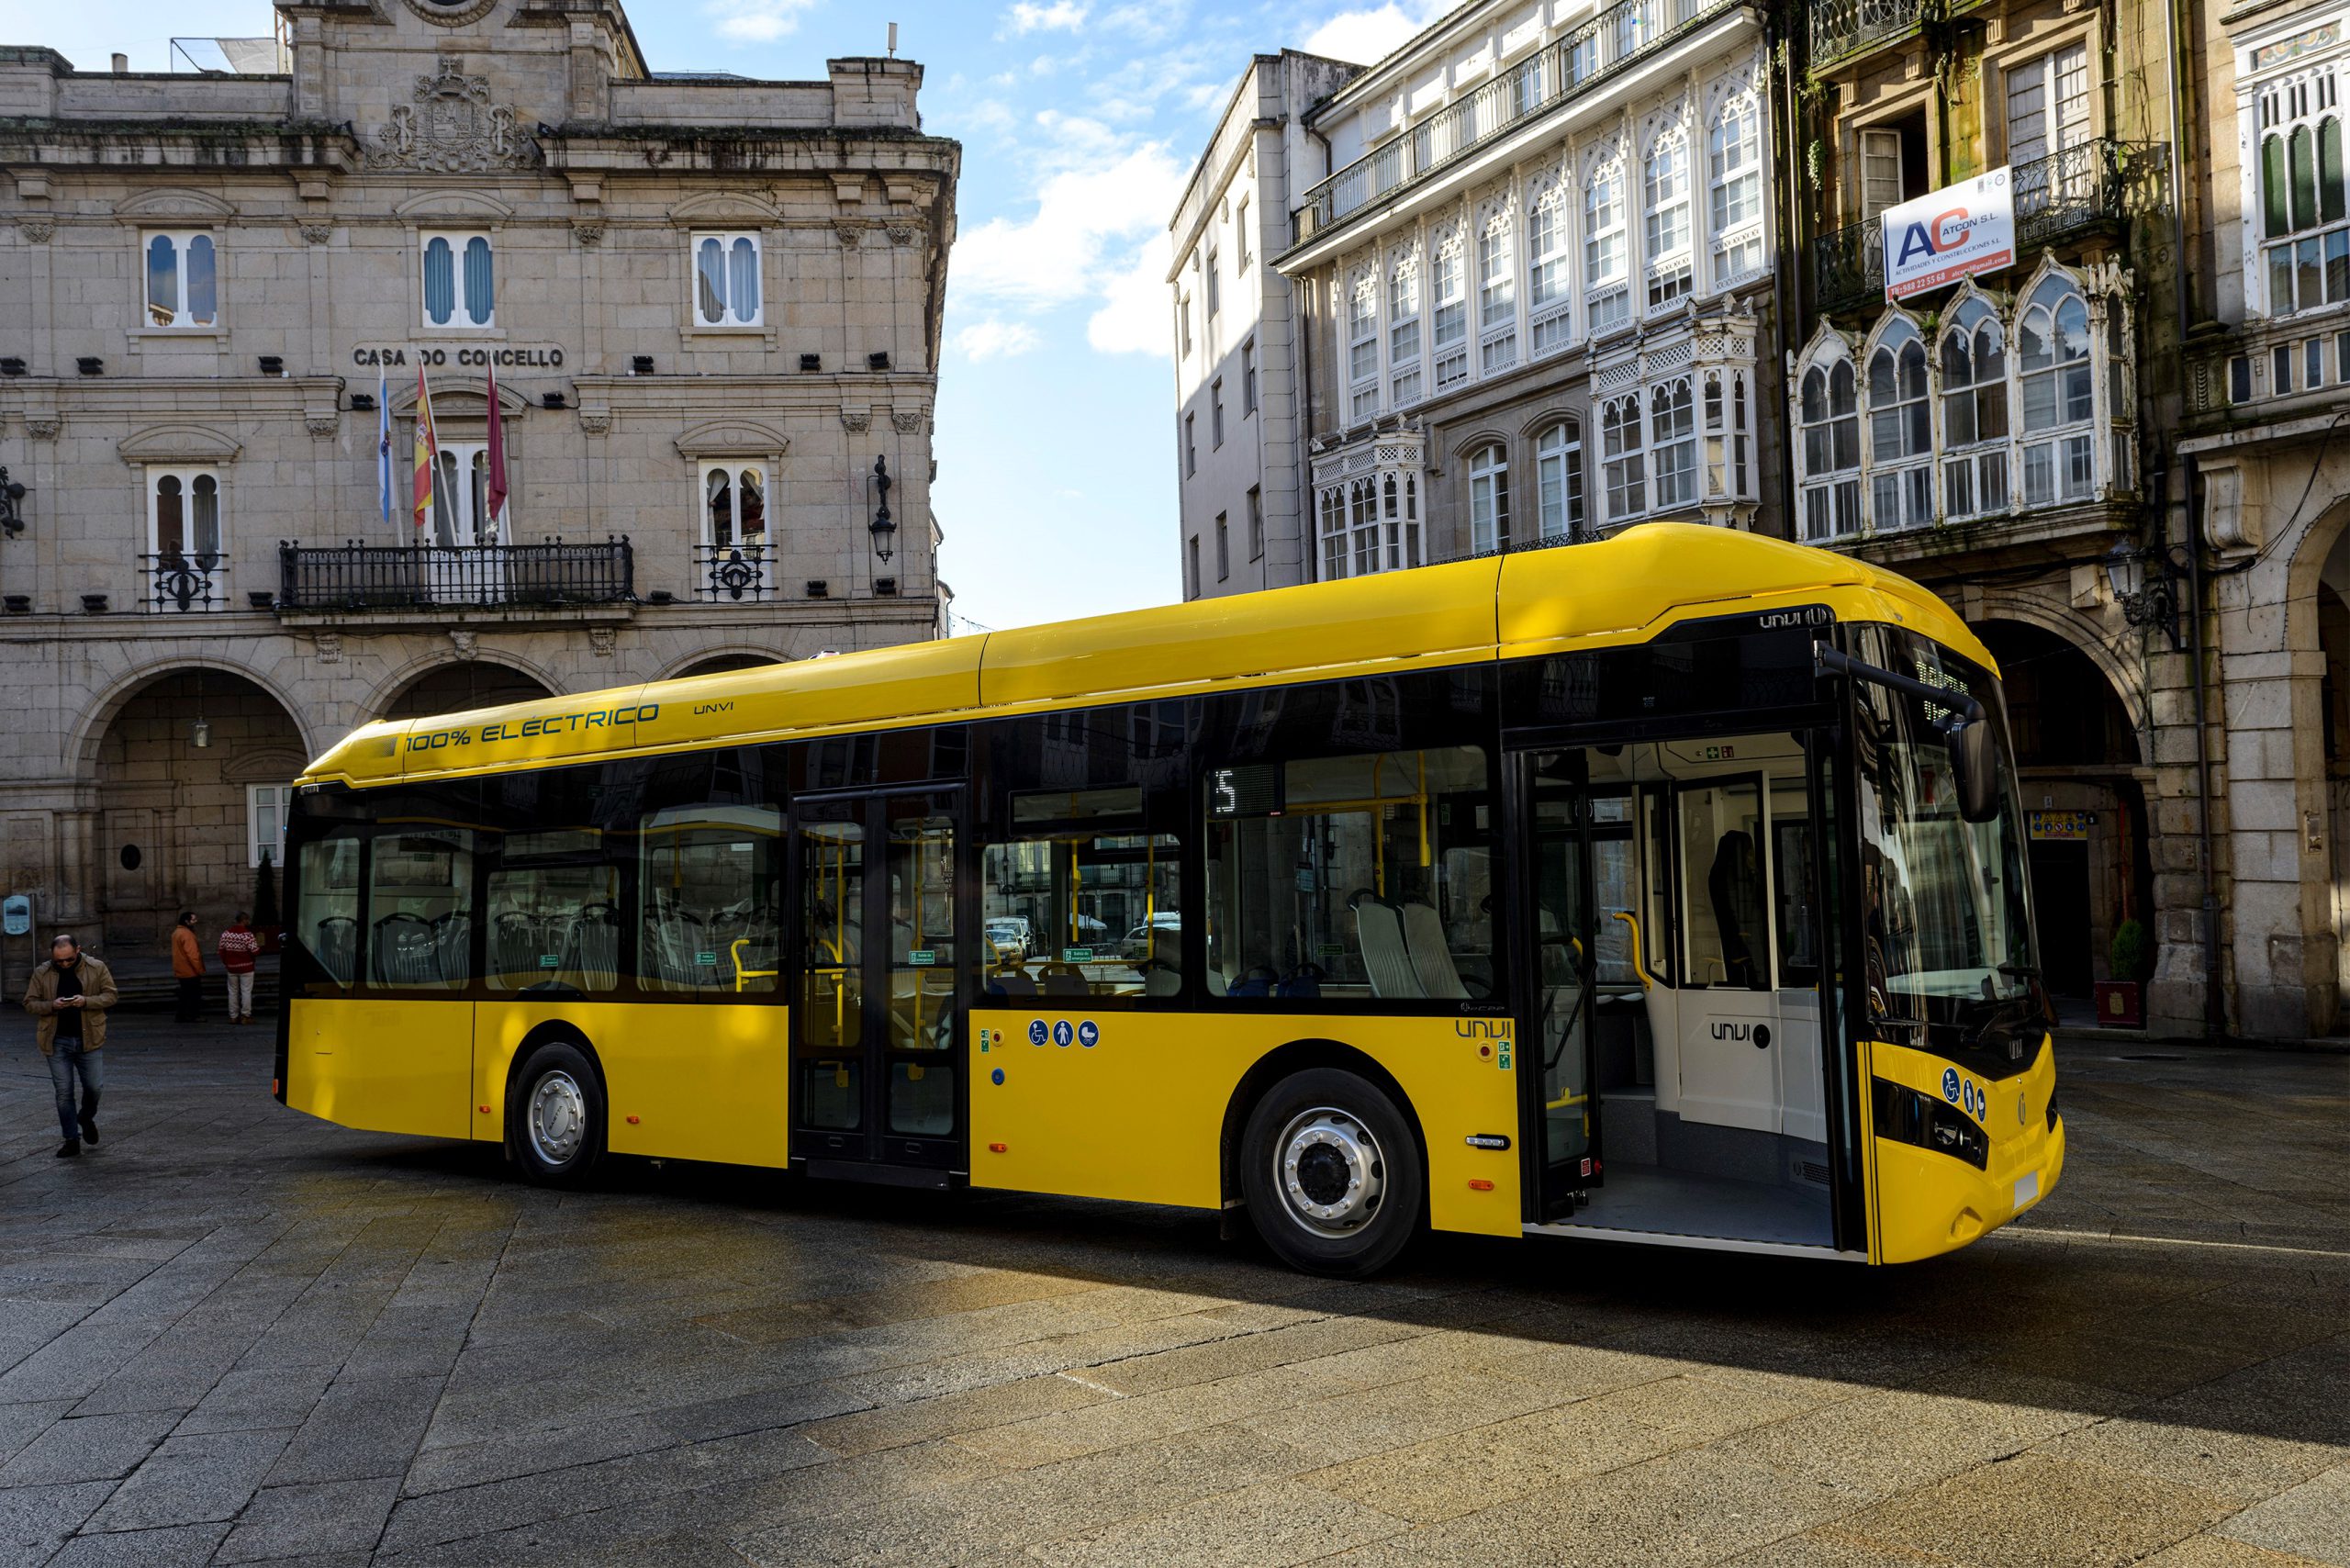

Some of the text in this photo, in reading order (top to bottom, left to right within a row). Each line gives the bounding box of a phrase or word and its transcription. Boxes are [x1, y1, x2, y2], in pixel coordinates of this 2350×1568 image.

[1897, 207, 1970, 267] AC
[1942, 212, 1998, 236] ATCON S.L.
[1895, 260, 1930, 275] ACTIVIDADES
[1937, 241, 1990, 263] CONSTRUCCIONES
[1917, 278, 1926, 288] 22
[1927, 274, 1935, 286] 55
[1936, 272, 1946, 282] 68
[353, 348, 564, 367] CASA DO CONCELLO
[693, 701, 734, 715] UNVI
[407, 703, 659, 752] 100% ELÉCTRICO
[1215, 769, 1235, 812] 5
